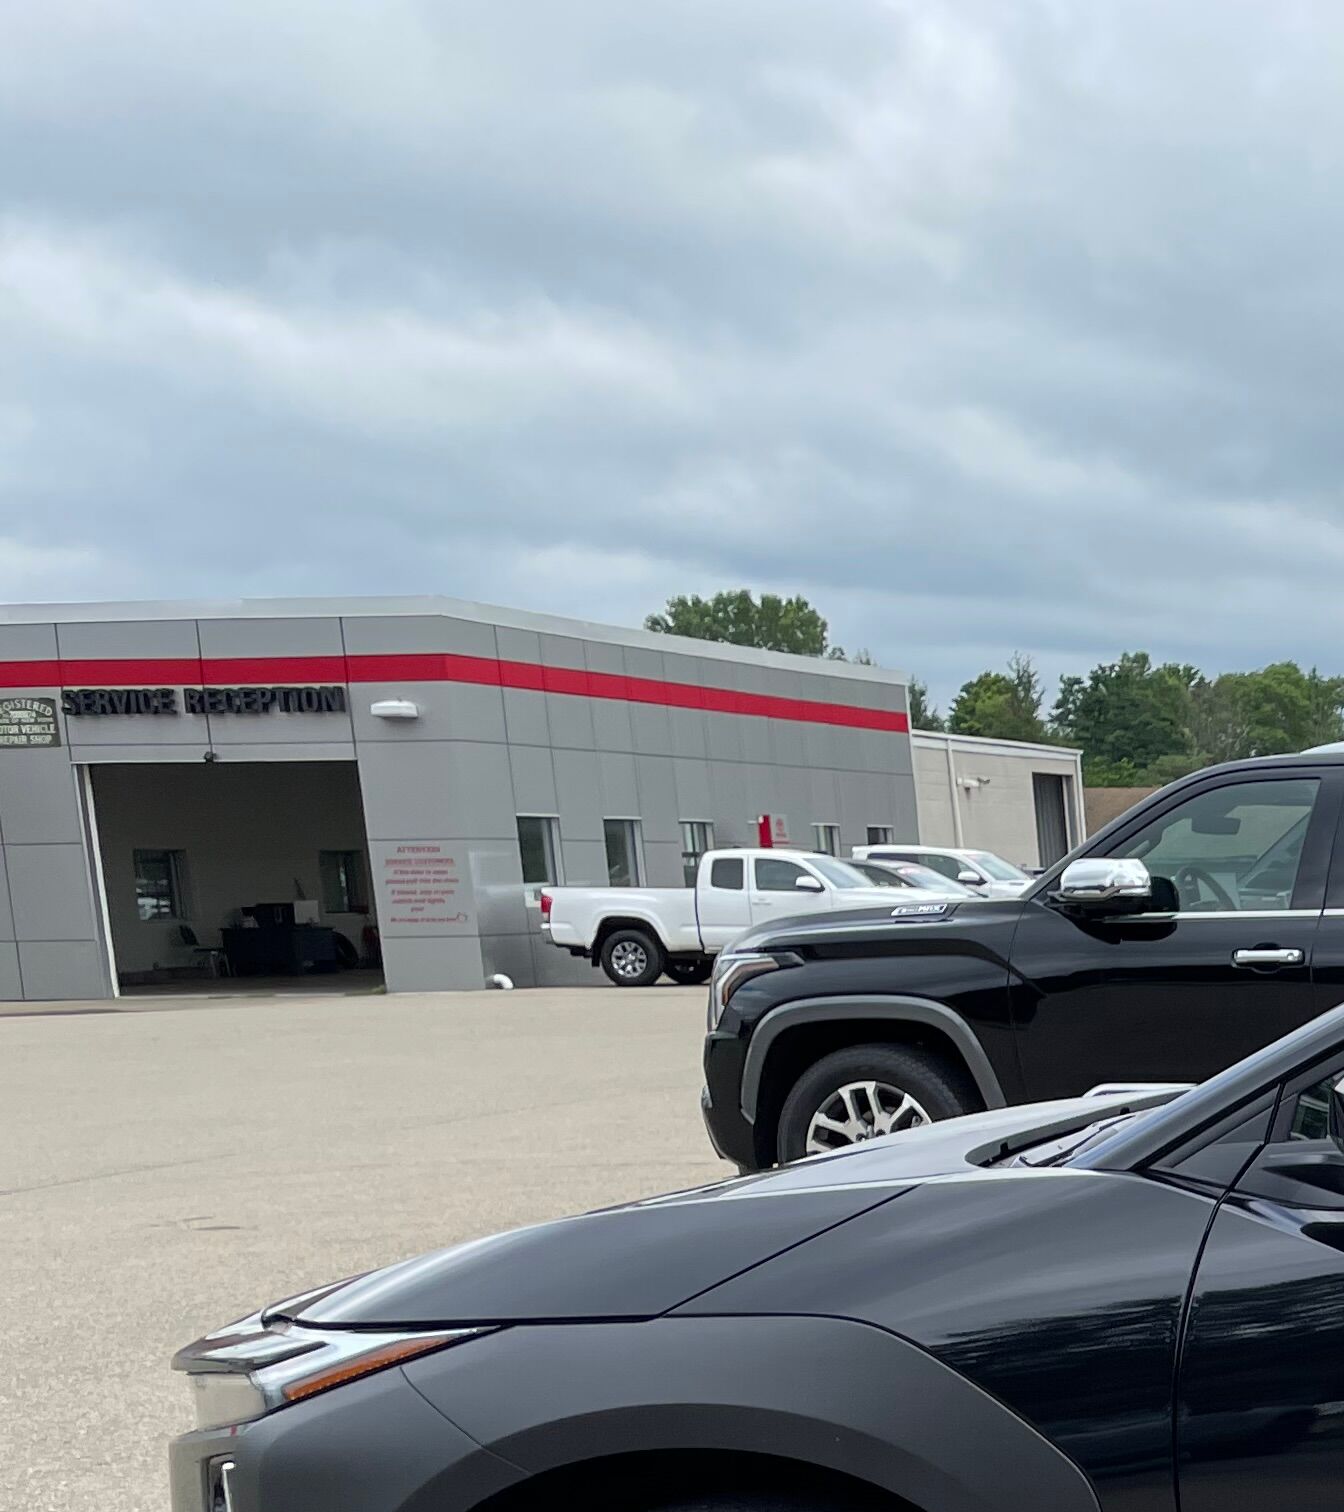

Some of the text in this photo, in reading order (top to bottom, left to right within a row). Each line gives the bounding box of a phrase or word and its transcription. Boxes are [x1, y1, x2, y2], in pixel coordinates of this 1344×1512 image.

[61, 686, 345, 715] SERVICE RECEPTION
[0, 699, 53, 716] GISTERED
[20, 724, 56, 734] VEHICLE
[30, 735, 52, 745] SHOP
